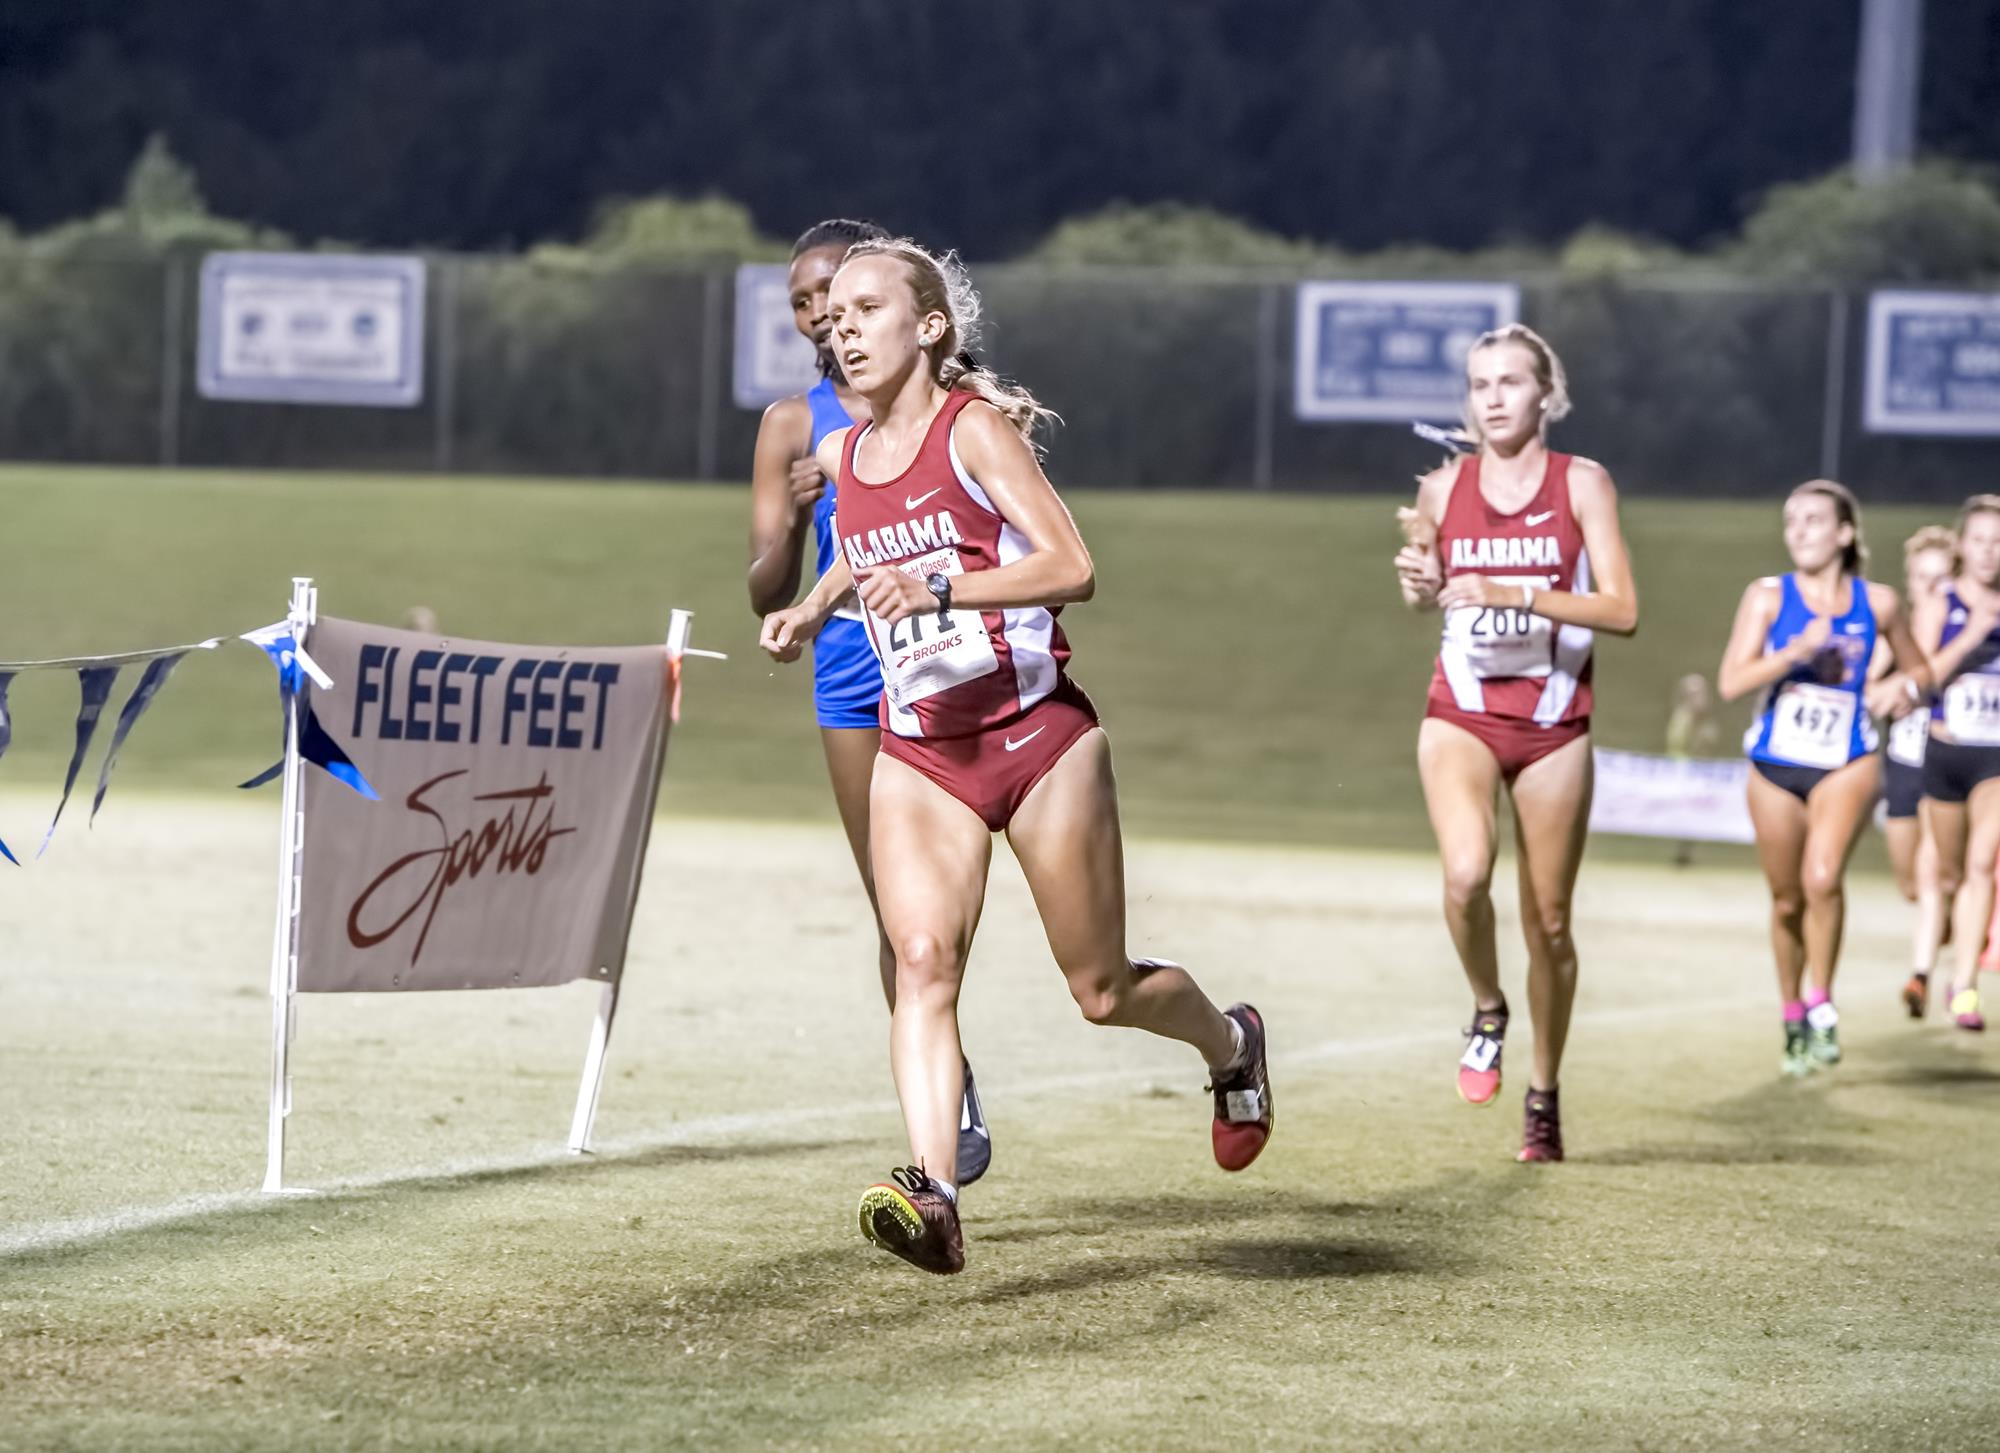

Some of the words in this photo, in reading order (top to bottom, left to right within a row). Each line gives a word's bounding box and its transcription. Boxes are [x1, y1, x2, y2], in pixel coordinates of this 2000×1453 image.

[843, 510, 963, 571] ALABAMA
[1450, 536, 1562, 567] ALABAMA
[913, 633, 963, 662] BROOKS
[352, 644, 505, 744] FLEET
[500, 656, 621, 750] FEET
[346, 768, 577, 968] Sports
